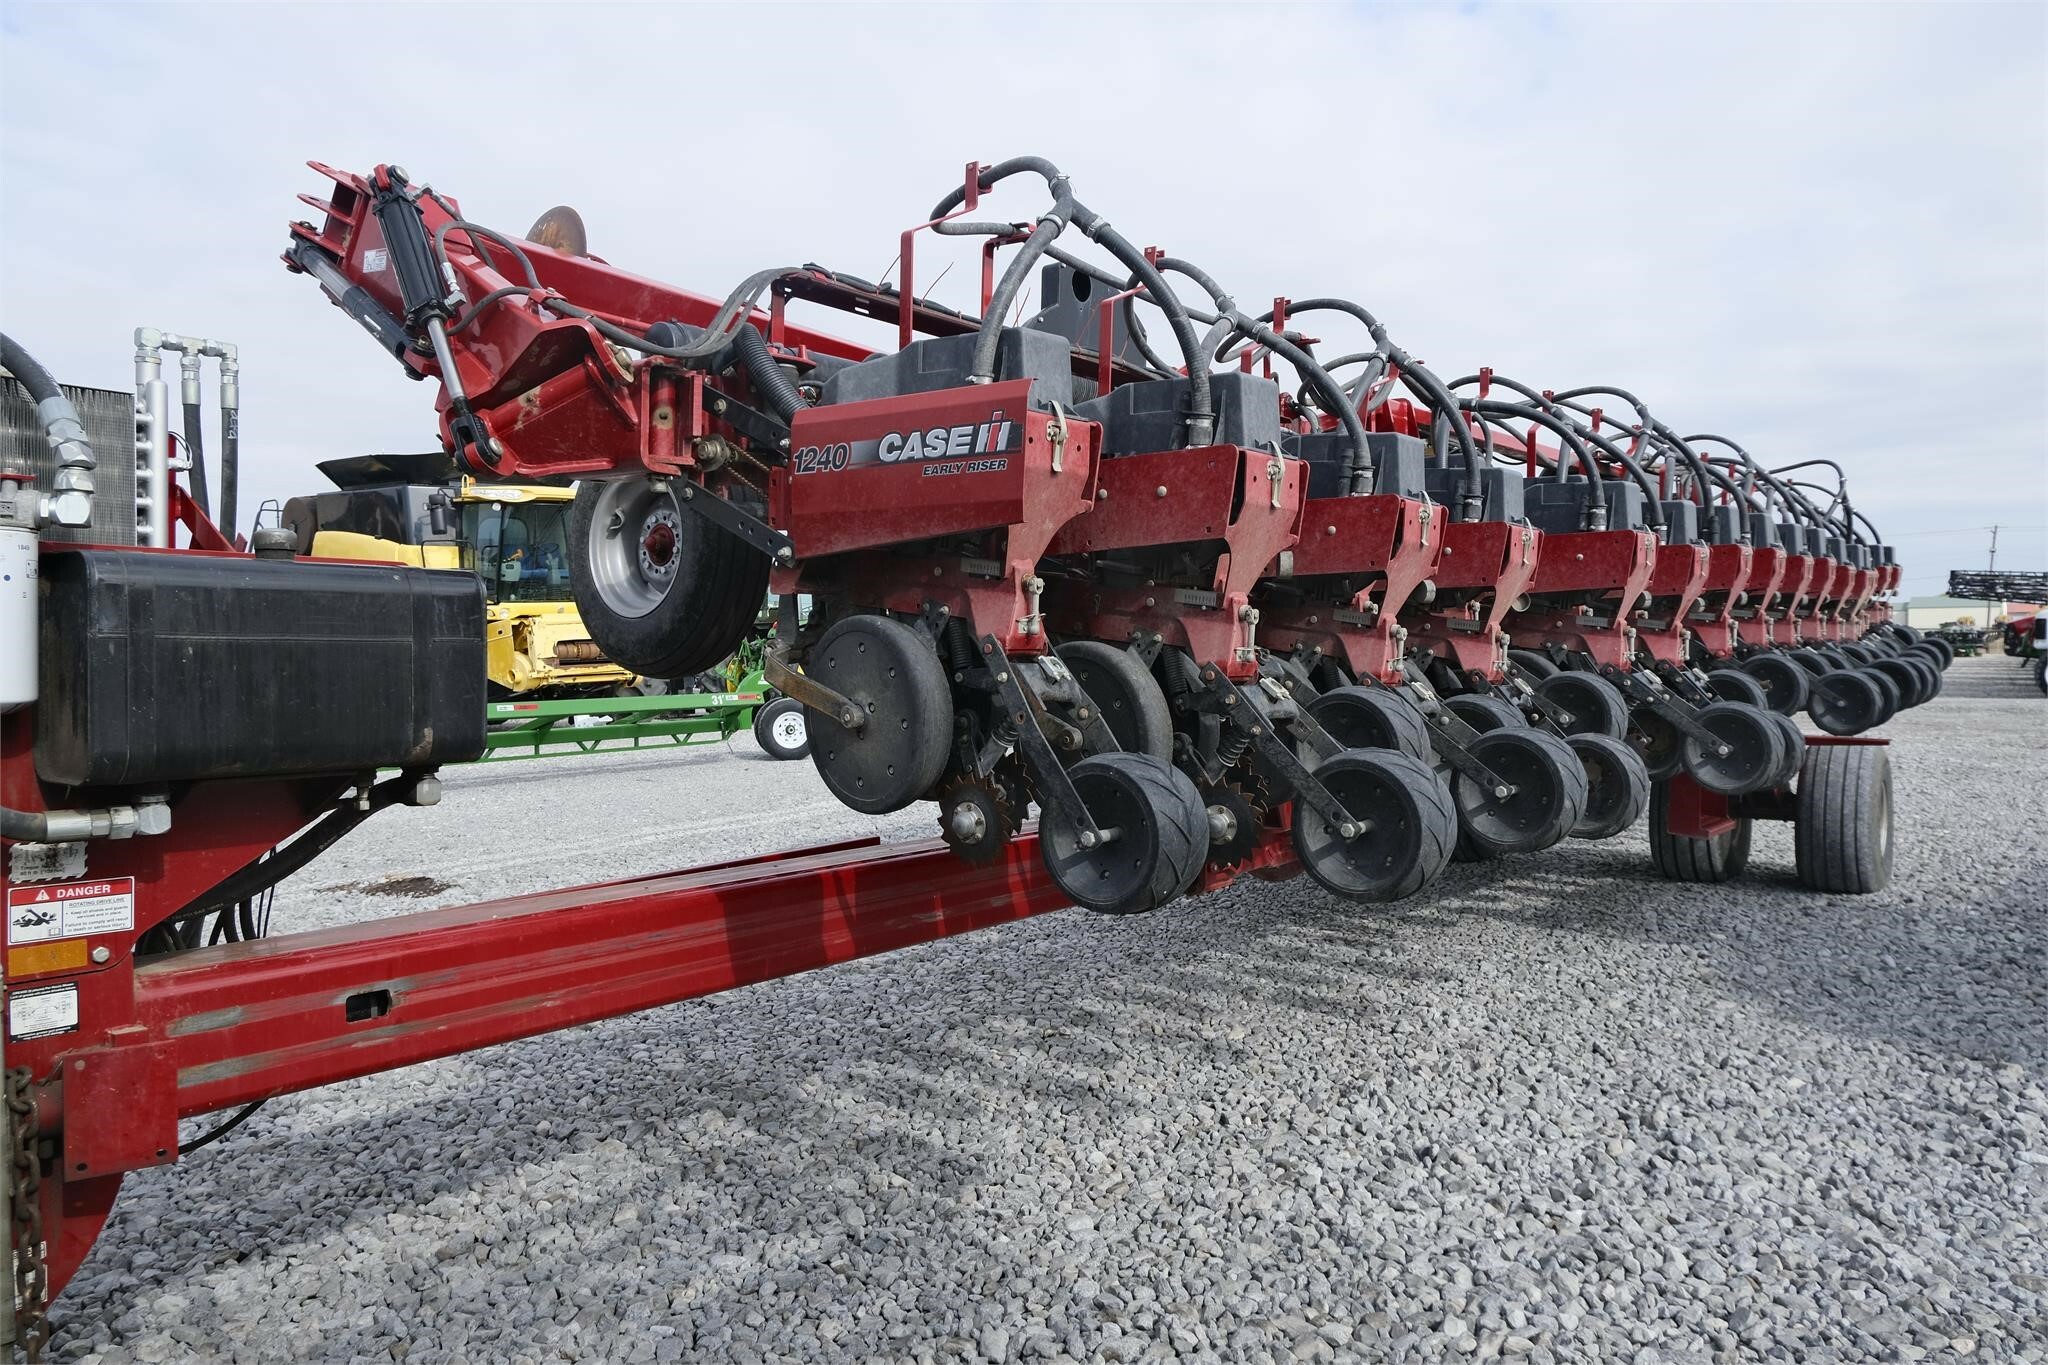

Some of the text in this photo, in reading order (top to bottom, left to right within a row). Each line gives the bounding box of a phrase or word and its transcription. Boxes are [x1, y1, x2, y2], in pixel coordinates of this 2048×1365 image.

[793, 442, 849, 474] 1240
[879, 426, 974, 462] CASE
[922, 458, 1007, 477] EARLY RISER
[57, 884, 111, 898] DANGER
